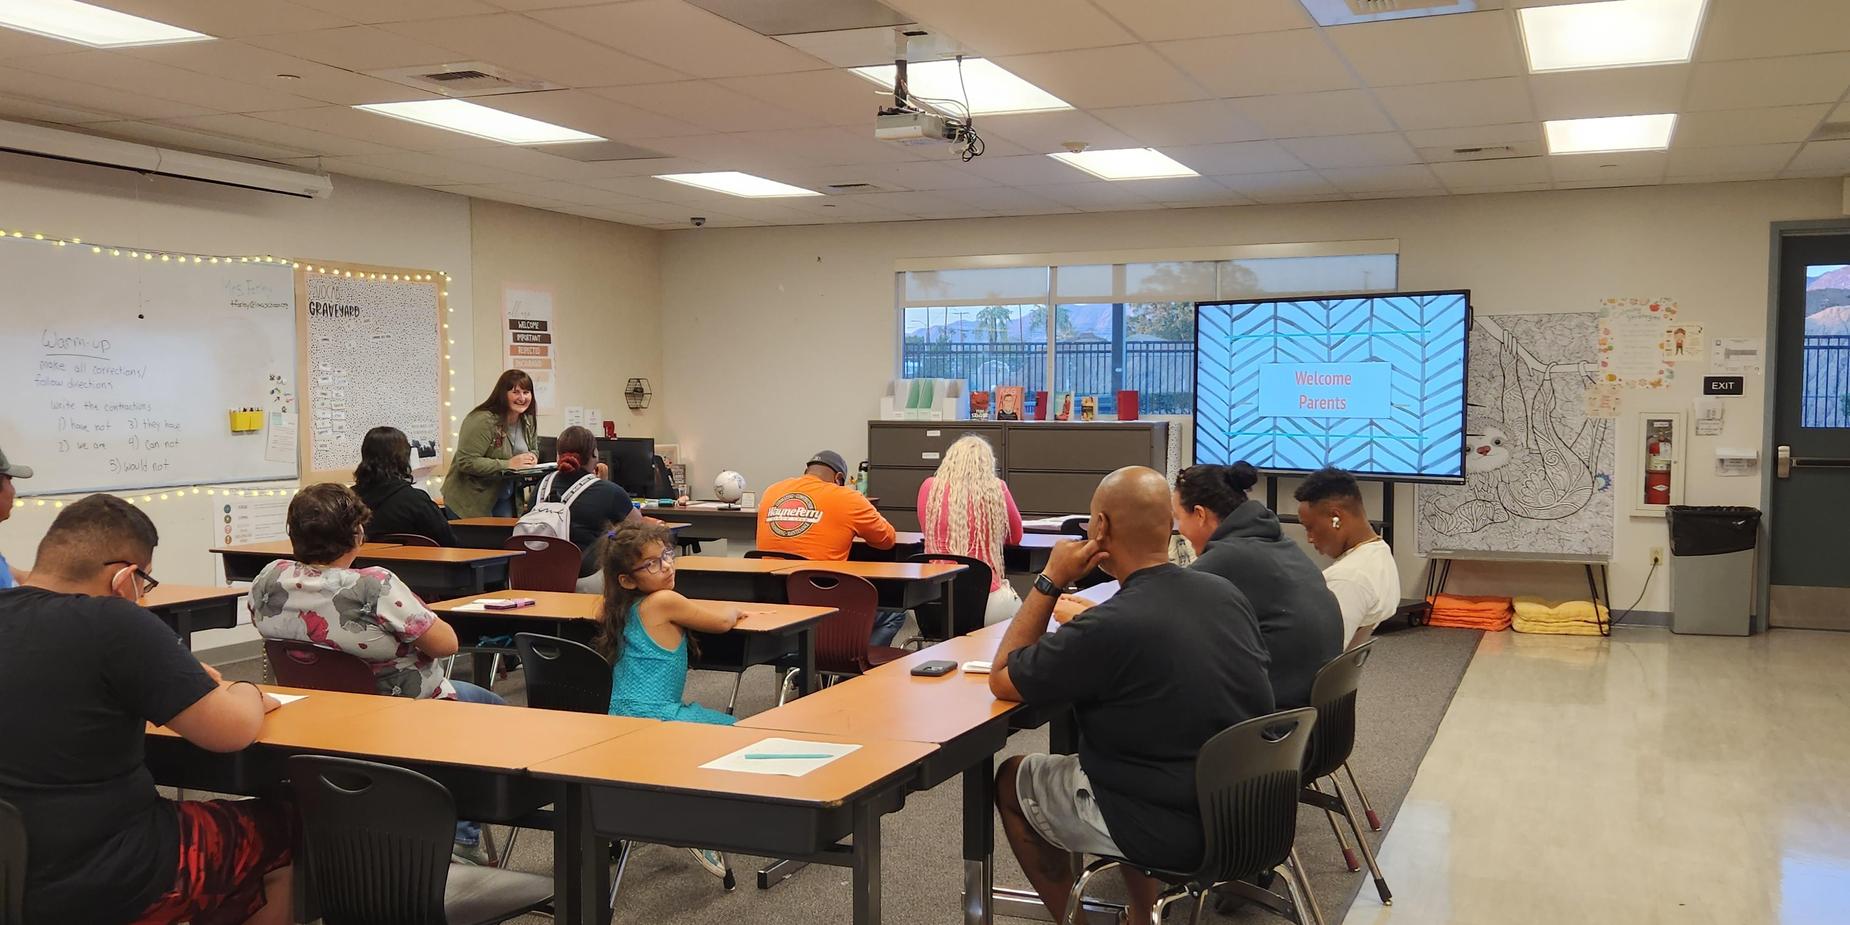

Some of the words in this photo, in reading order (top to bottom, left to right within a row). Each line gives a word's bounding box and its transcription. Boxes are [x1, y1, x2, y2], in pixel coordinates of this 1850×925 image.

[309, 301, 360, 318] GRAVEYARD
[517, 320, 540, 330] WELCOME
[41, 329, 111, 353] Warm-up
[74, 361, 86, 373] all
[1295, 371, 1352, 385] Welcome
[1711, 381, 1735, 390] EXIT
[84, 401, 99, 411] the
[1299, 394, 1347, 410] Parents
[95, 422, 112, 431] not
[127, 417, 138, 430] 3)
[164, 439, 181, 449] not
[153, 458, 170, 472] not
